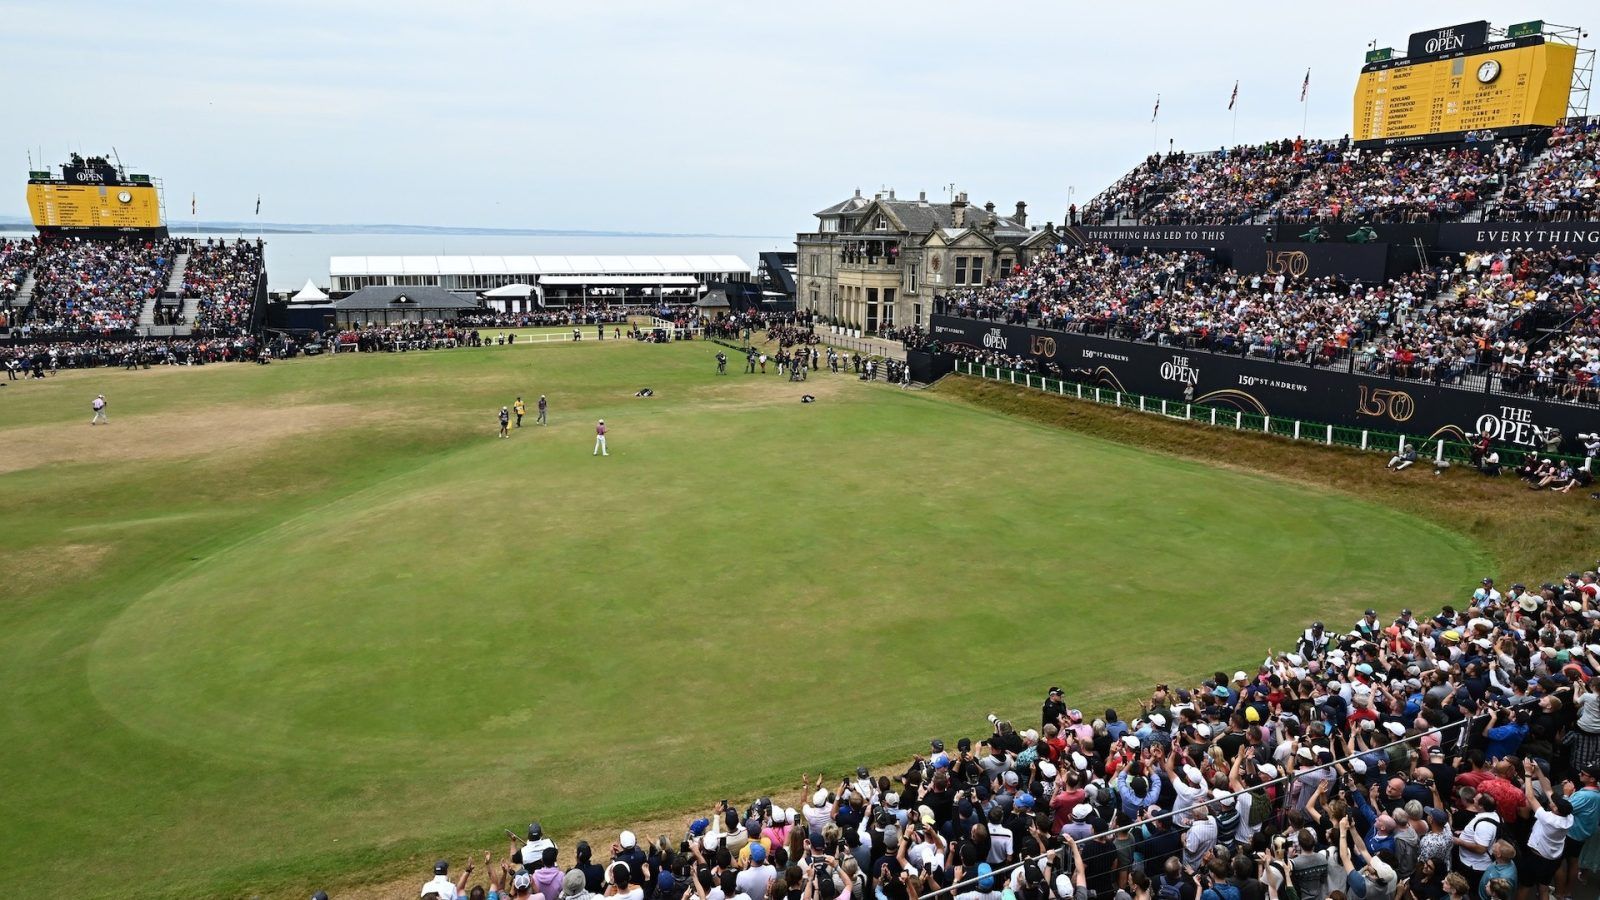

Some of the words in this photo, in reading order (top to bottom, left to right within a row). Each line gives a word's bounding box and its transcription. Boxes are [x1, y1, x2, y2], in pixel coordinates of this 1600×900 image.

[1438, 29, 1454, 38] THE
[1425, 35, 1464, 54] OPEN
[77, 172, 103, 181] OPEN
[1088, 231, 1140, 240] EVERYTHING
[1143, 232, 1160, 240] HAS
[1164, 232, 1181, 240] LED
[1185, 232, 1198, 240] TO
[1202, 232, 1225, 240] THIS
[1476, 231, 1600, 243] EVERYTHING
[1266, 250, 1308, 276] 150
[990, 328, 1001, 337] THE
[983, 333, 1008, 350] OPEN
[1030, 334, 1057, 357] 150
[1103, 353, 1128, 362] ANDREWS
[1172, 355, 1189, 367] THE
[1160, 361, 1199, 384] OPEN
[1270, 380, 1308, 392] ANDREWS
[1356, 385, 1414, 421] 150
[1500, 406, 1532, 423] THE
[1476, 414, 1552, 447] OPEN
